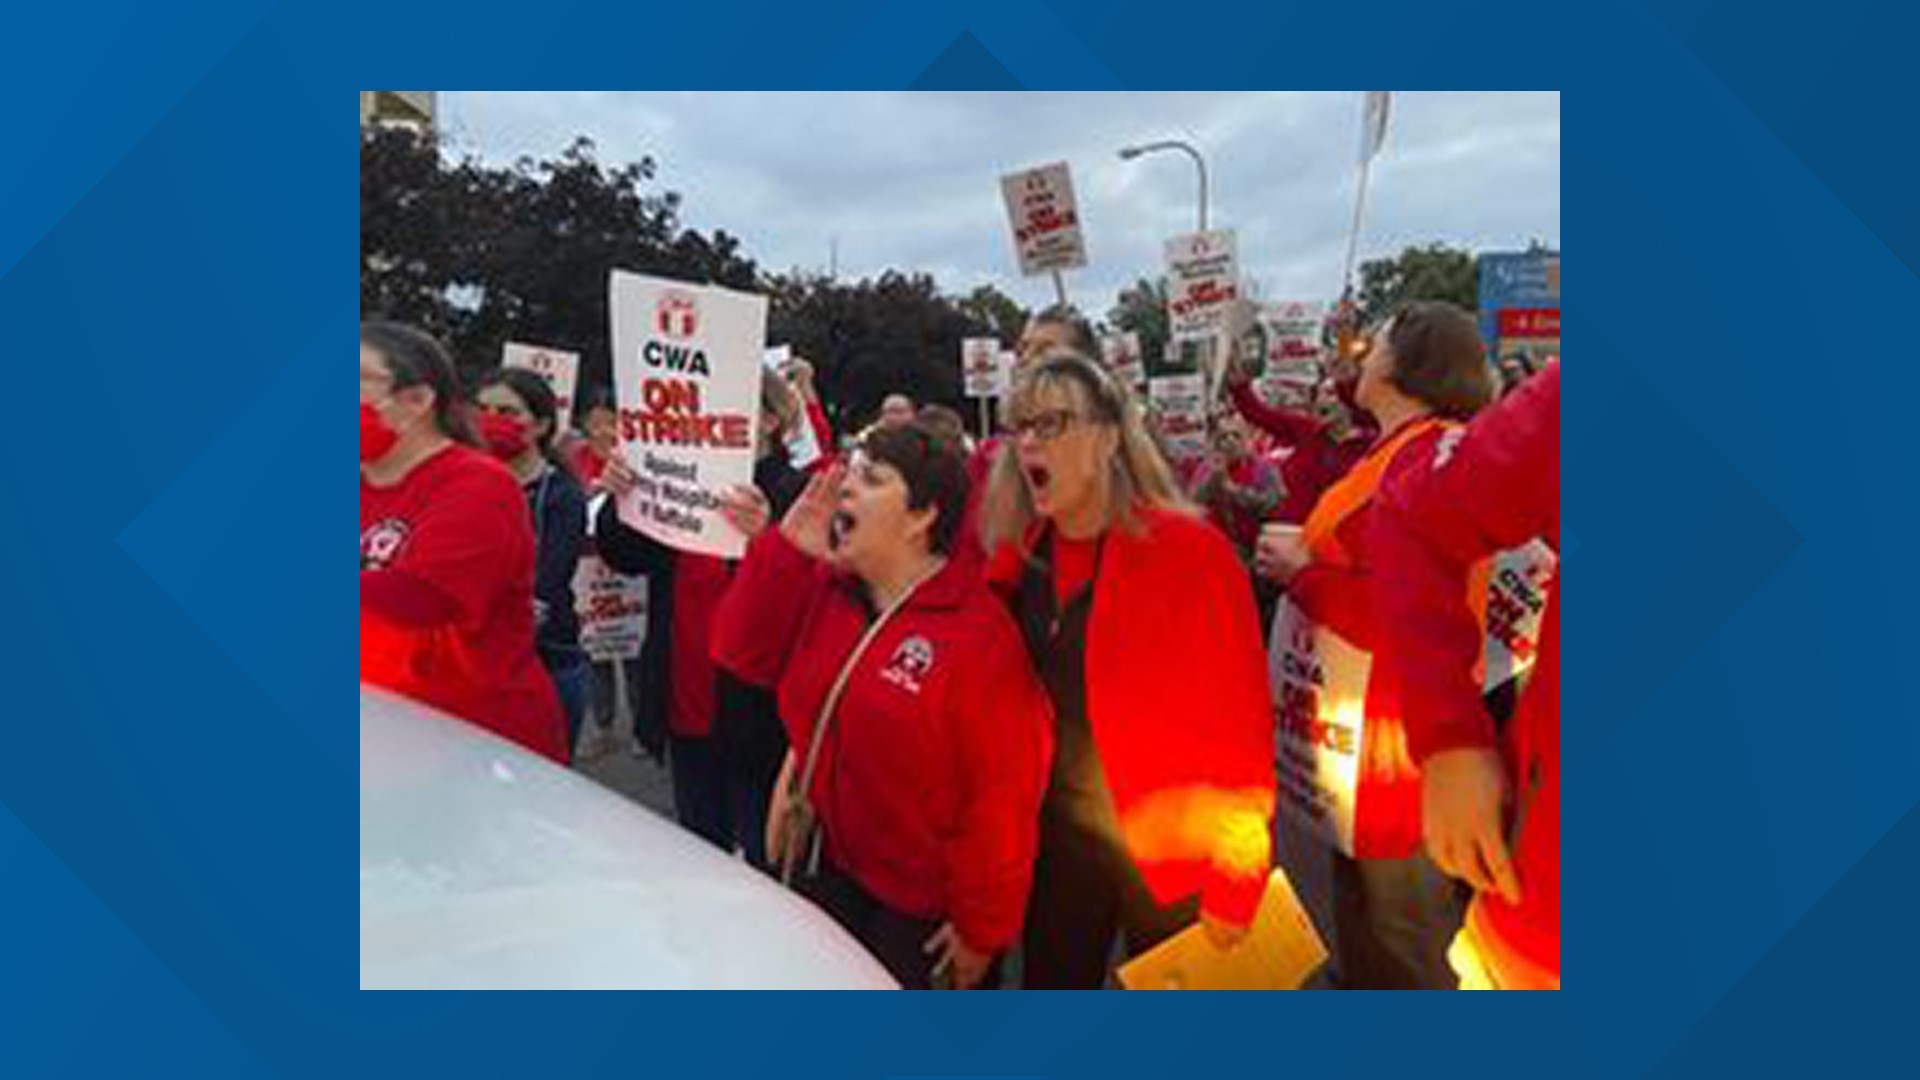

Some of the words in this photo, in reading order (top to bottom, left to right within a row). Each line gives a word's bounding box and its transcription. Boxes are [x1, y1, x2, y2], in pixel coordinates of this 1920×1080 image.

[642, 340, 710, 377] CWA
[644, 377, 701, 417] ON
[619, 408, 750, 448] STRIKE
